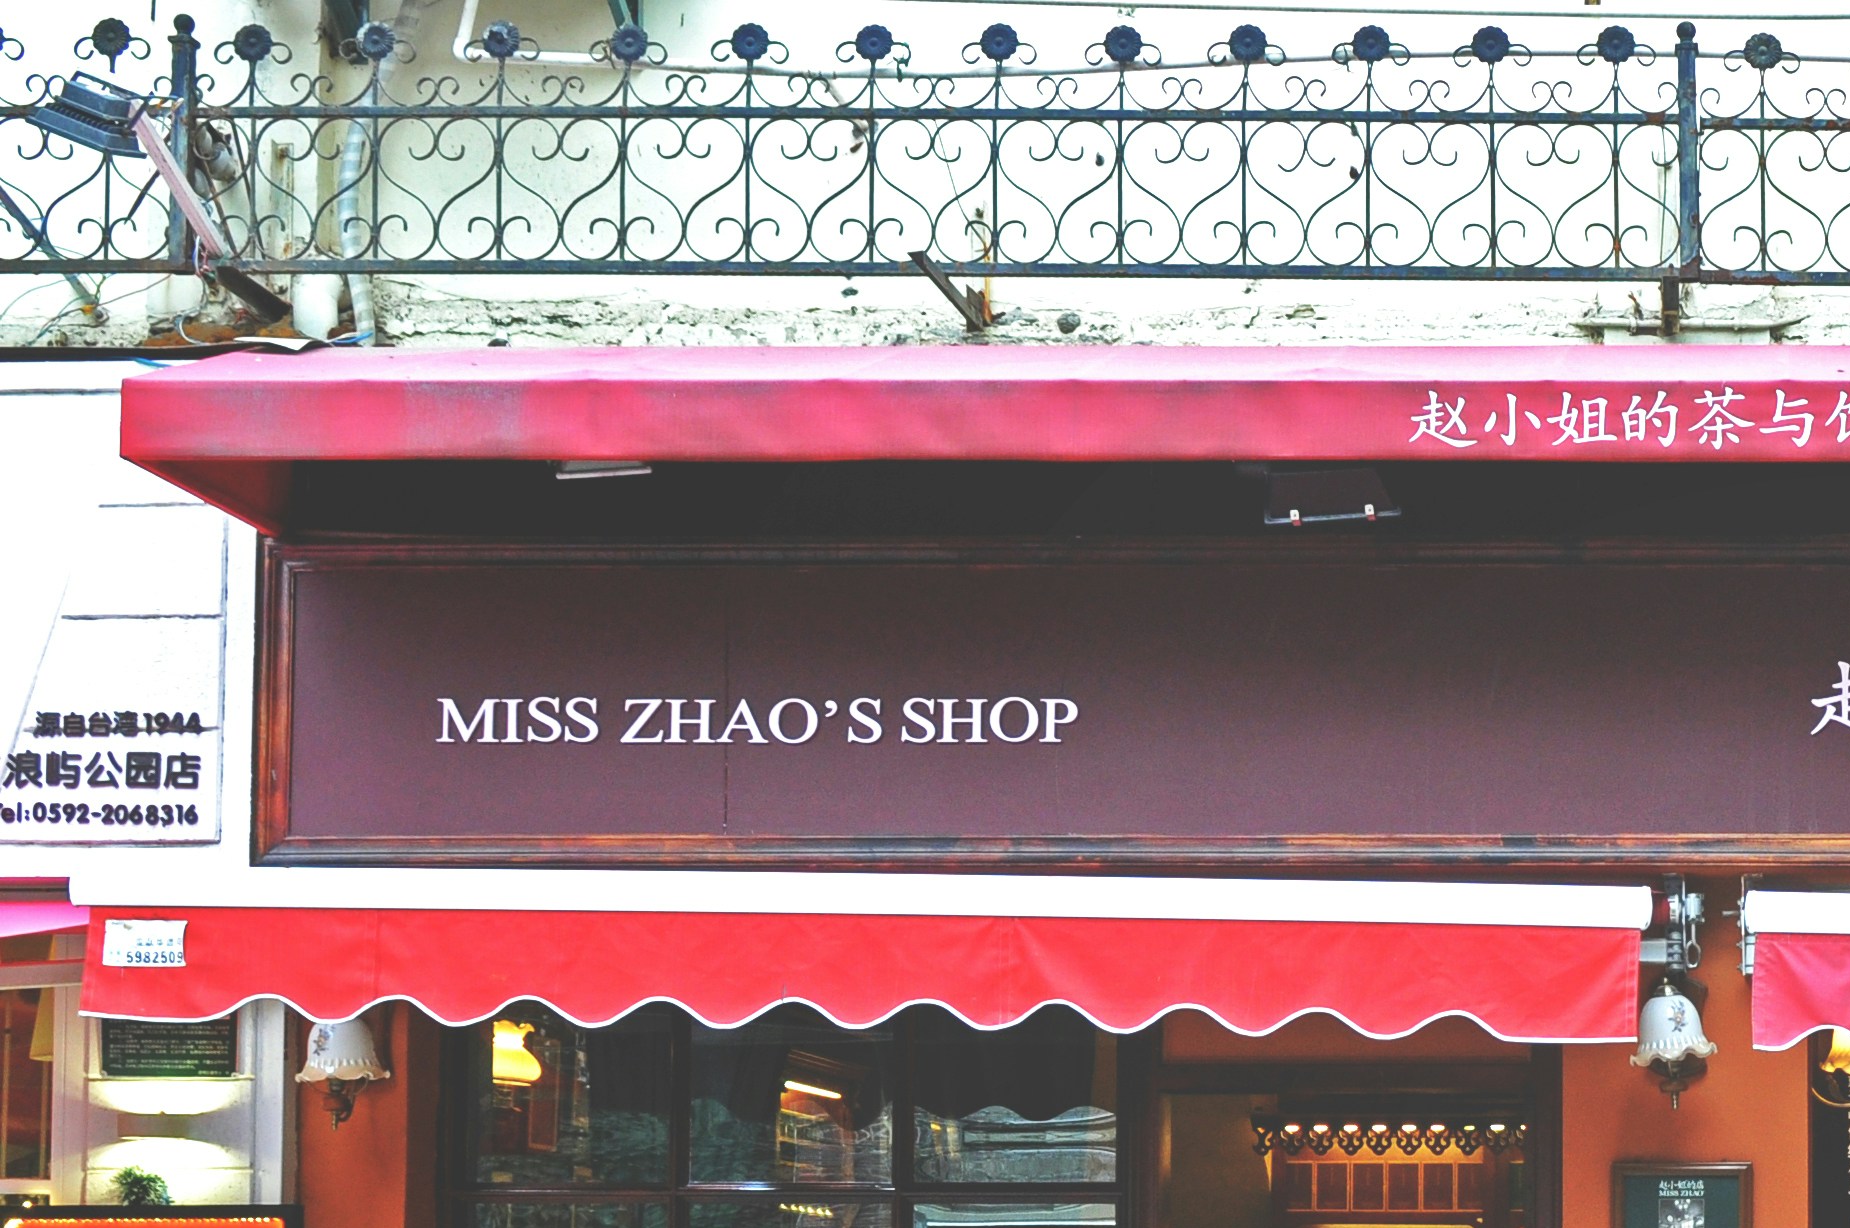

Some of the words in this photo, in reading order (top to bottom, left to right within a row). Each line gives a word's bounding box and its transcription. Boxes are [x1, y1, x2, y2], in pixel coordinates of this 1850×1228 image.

[436, 697, 598, 743] MISS
[620, 697, 883, 743] ZHAO'S
[901, 697, 1078, 743] SHOP
[0, 801, 199, 826] el:0592-2068316
